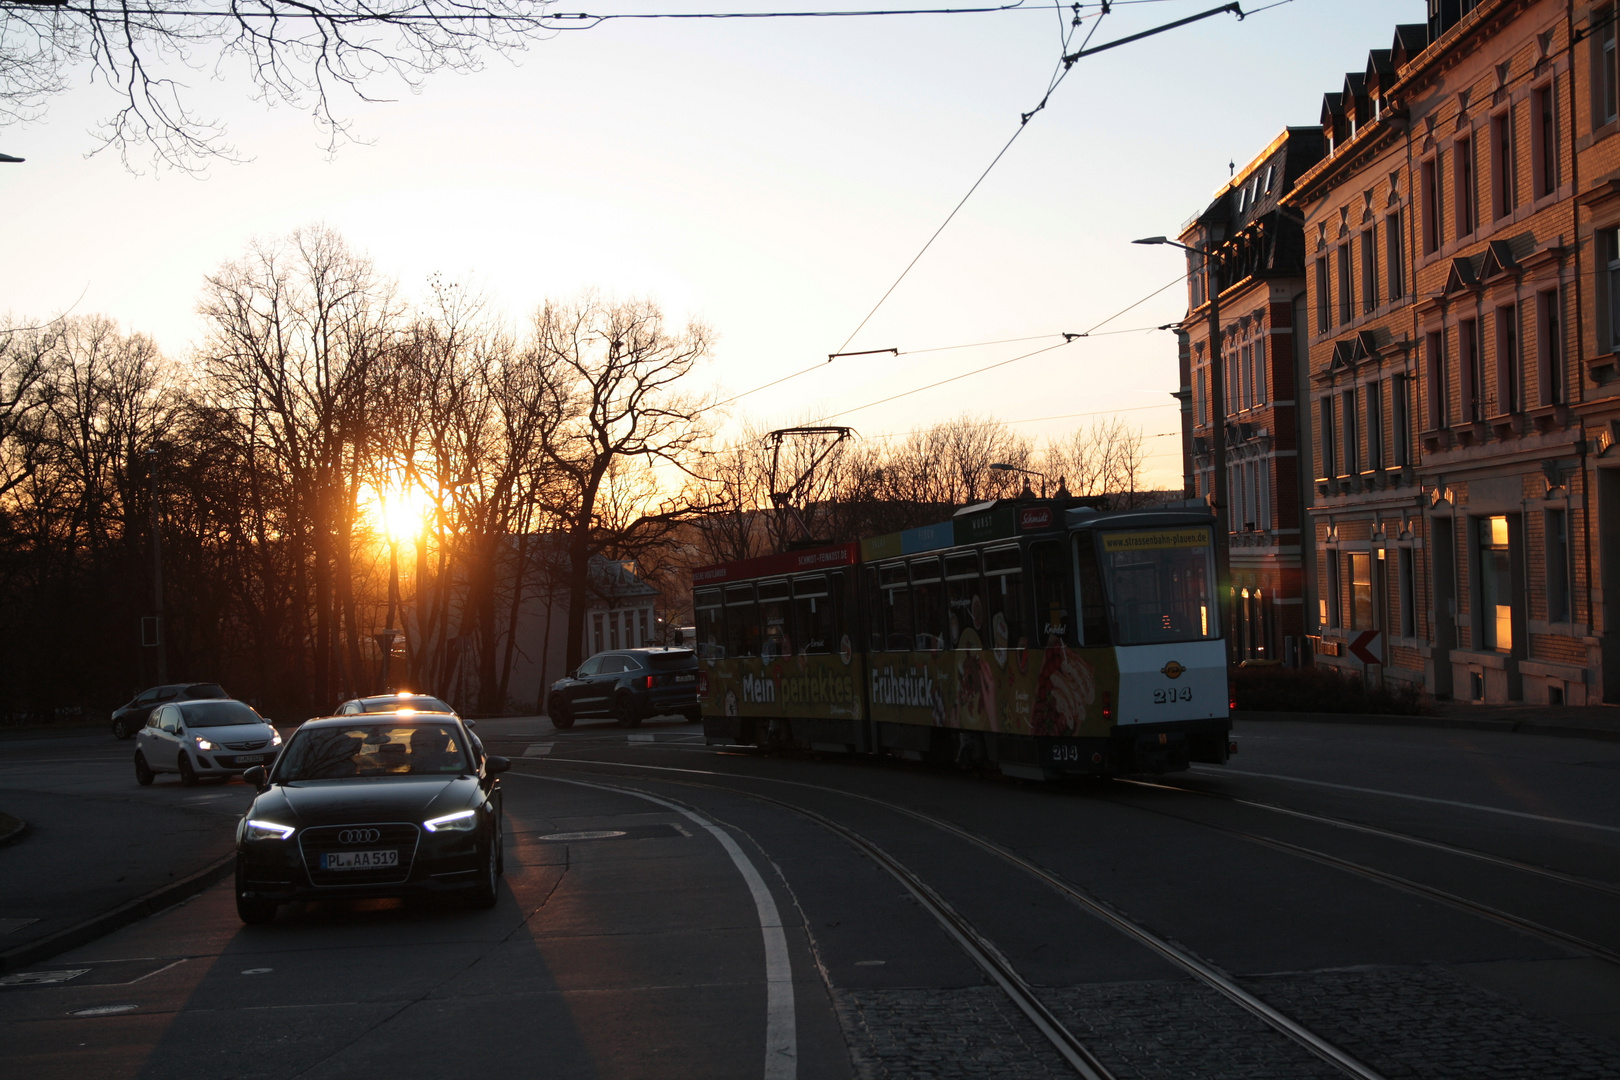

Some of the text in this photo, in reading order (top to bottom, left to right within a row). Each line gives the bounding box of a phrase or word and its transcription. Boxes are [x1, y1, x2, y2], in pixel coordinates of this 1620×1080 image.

[972, 516, 992, 529] WURST
[1022, 513, 1048, 524] Schmidt
[1106, 533, 1207, 547] www.strassenbahn-plauen.de
[798, 550, 848, 566] SCHMIDT-FEINKOST.DE
[743, 665, 933, 714] Mein perfektes Frühstück
[1154, 687, 1192, 704] 214
[1052, 745, 1079, 761] 214
[328, 852, 397, 866] PL AA 519
